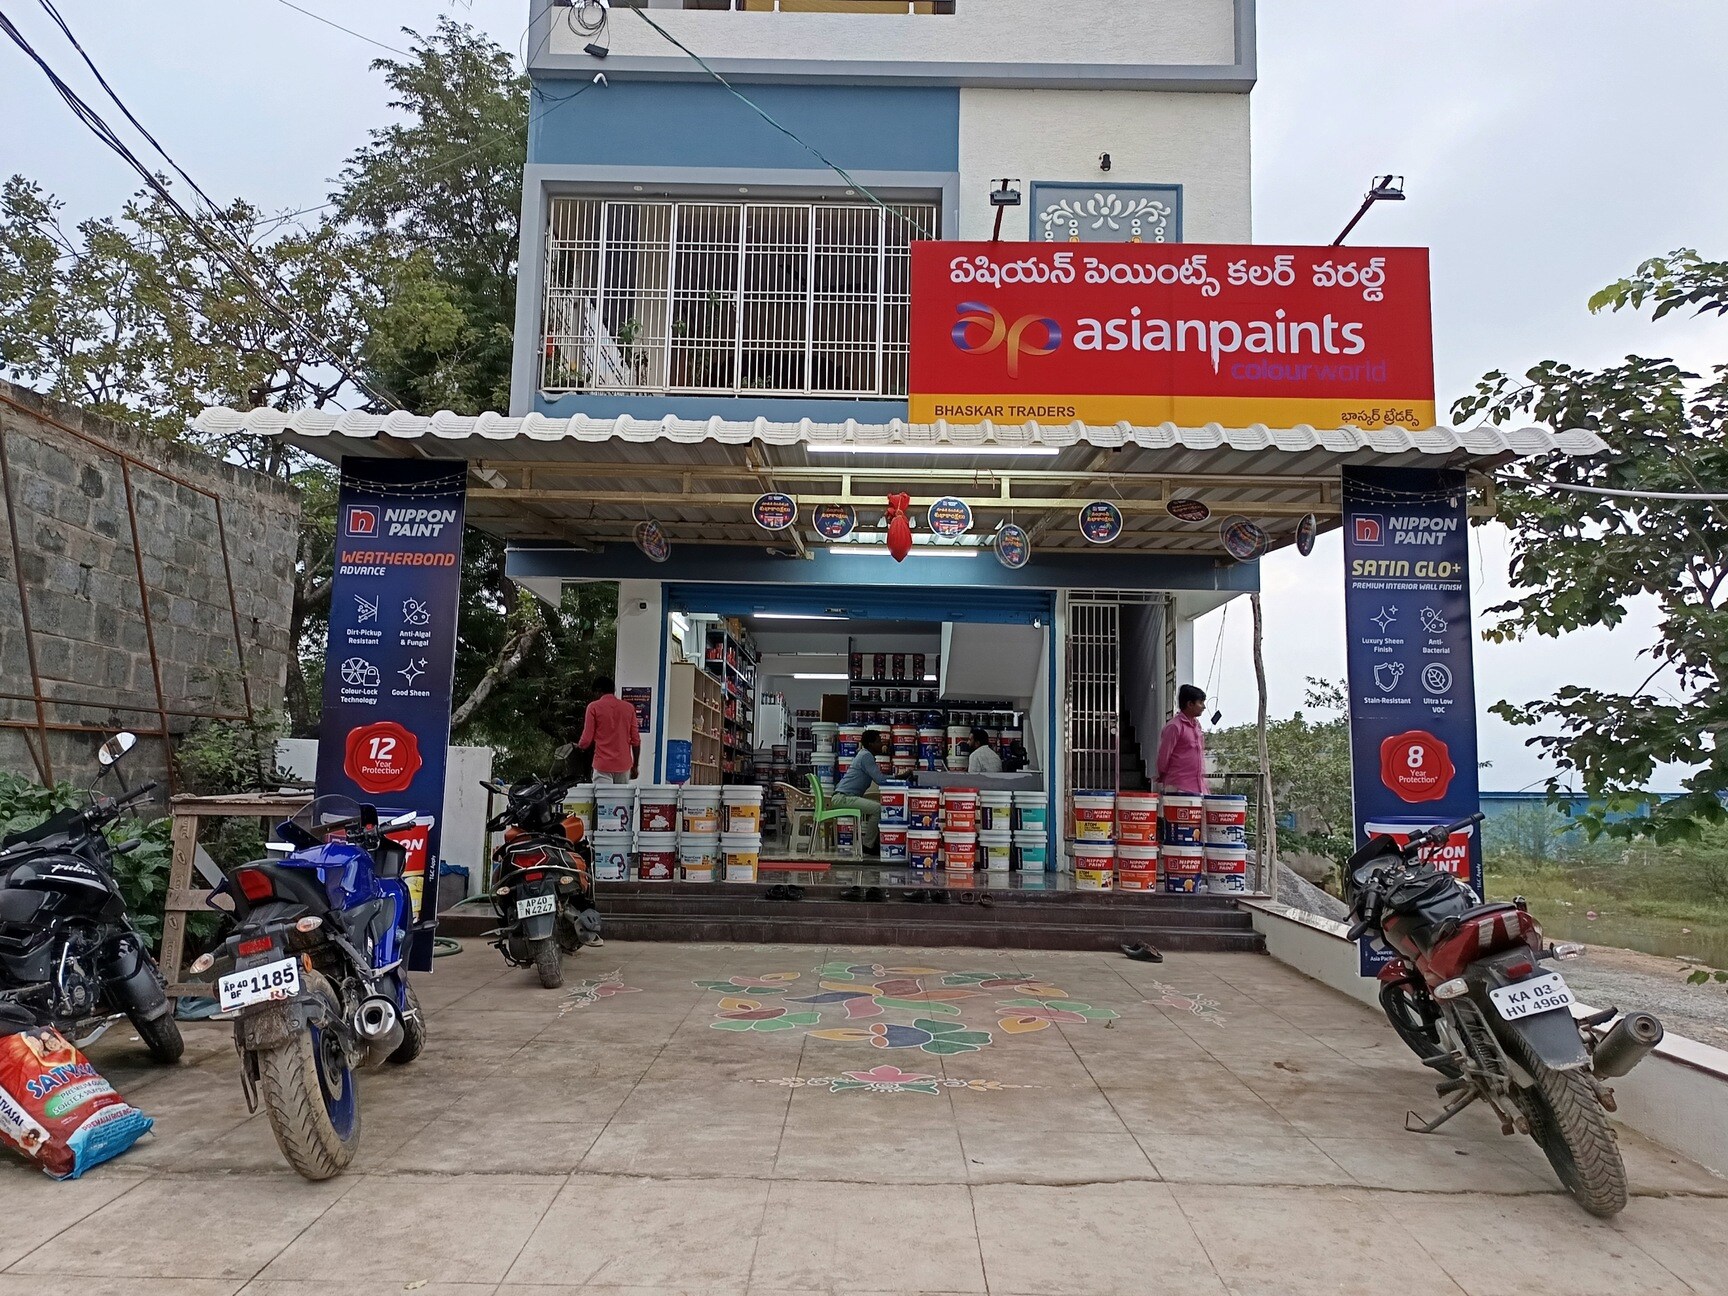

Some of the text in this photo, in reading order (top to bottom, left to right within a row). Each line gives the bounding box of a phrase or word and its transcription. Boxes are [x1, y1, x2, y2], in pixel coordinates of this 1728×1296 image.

[950, 252, 1386, 302] ఏషియన్ పెయింట్స్ కలర్ వరల్డ్
[1073, 308, 1366, 376] asianpaints
[934, 405, 1076, 418] BHASKAR TRADERS
[1341, 407, 1420, 427] భాస్కర్ ట్రేడర్స్
[384, 508, 457, 523] NIPPON
[1388, 516, 1458, 532] NIPPON
[388, 523, 444, 538] PAINT
[1394, 531, 1447, 545] PAINT
[341, 550, 456, 567] WEATHERBOND
[339, 566, 386, 576] ADVANCE
[1352, 559, 1462, 578] SATIN GLO+
[1352, 581, 1463, 591] PREMIUM INTERIOR WALL FINISH
[346, 628, 383, 638] Dirt-Pickup
[399, 630, 432, 638] Anti-Algal
[348, 637, 379, 645] Resistant
[400, 638, 429, 647] & Fungal
[1362, 637, 1384, 646] Luxury
[1422, 646, 1450, 654] Bacterial
[340, 688, 378, 696] Colour-Lock
[391, 689, 430, 697] Good Sheen
[340, 696, 378, 705] Technology
[1364, 697, 1411, 705] Stain-Resistant
[1423, 697, 1453, 705] Ultra Low
[1432, 706, 1446, 714] VOC
[368, 737, 397, 760] 12
[1407, 745, 1424, 768] 8
[374, 760, 392, 768] Year
[1409, 769, 1426, 777] Year
[251, 966, 294, 993] 1185
[224, 979, 248, 993] AP 40
[230, 989, 242, 999] BF
[1508, 984, 1553, 1004] KA 03
[1505, 993, 1569, 1017] HV 4960
